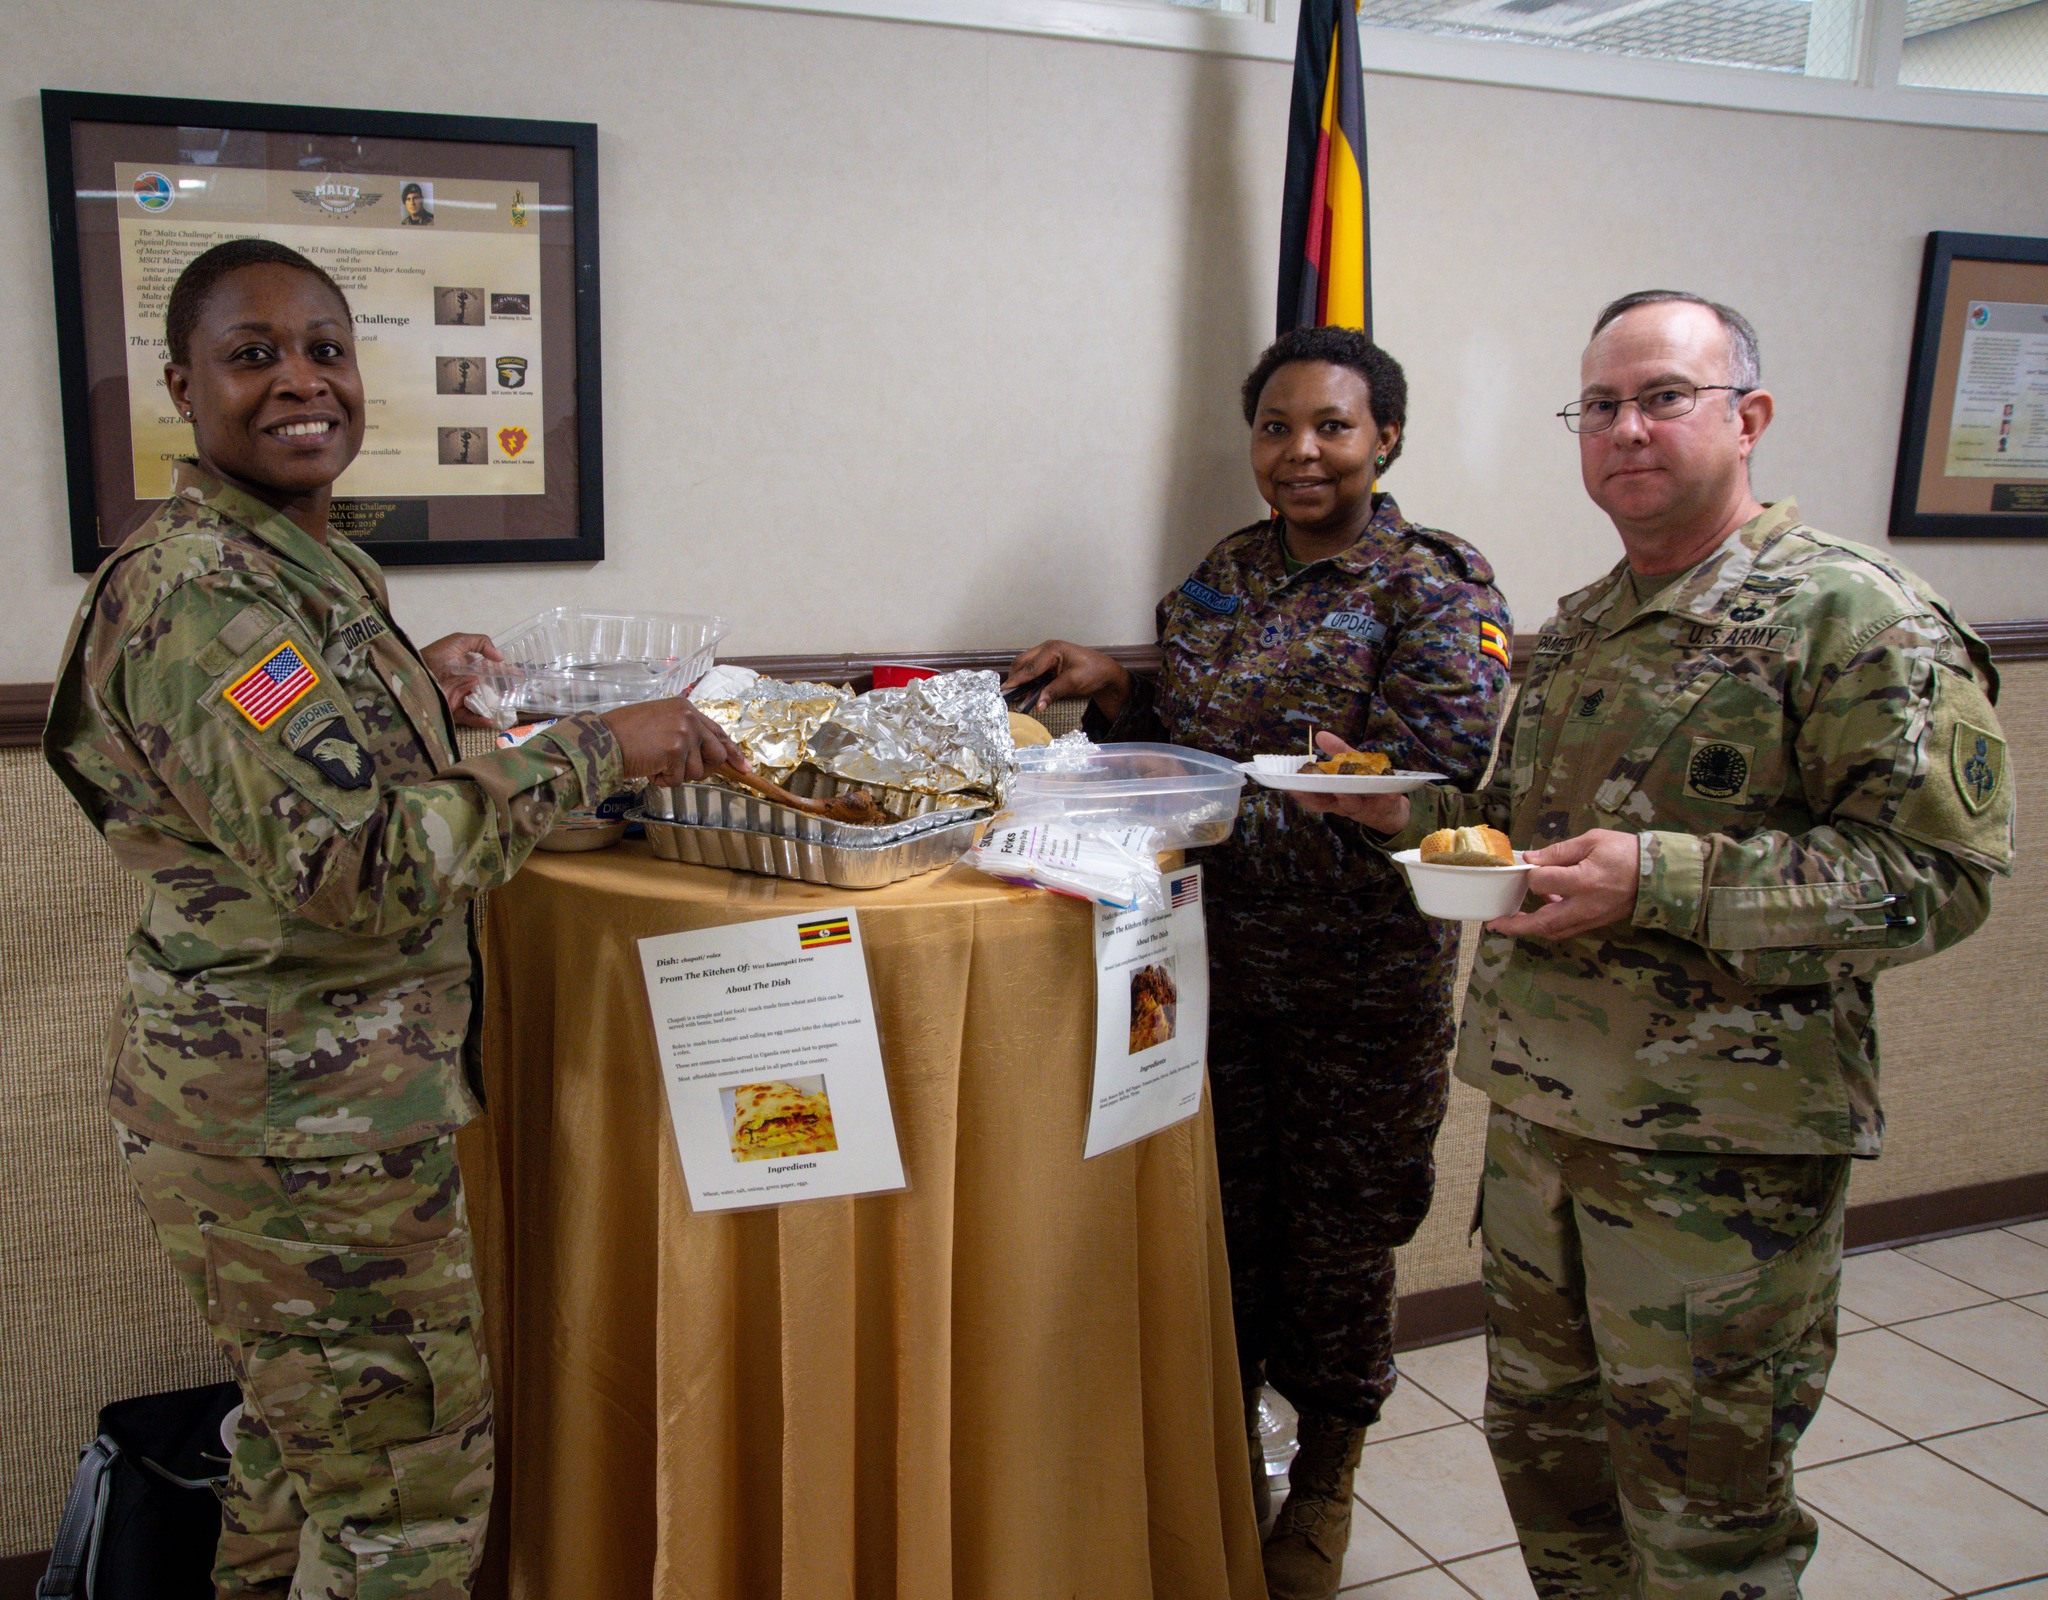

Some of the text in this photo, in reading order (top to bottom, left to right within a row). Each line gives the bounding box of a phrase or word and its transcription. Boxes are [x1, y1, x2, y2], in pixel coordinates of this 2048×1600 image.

[315, 184, 360, 197] MALTZ
[338, 247, 375, 255] Intelligence
[339, 265, 372, 273] Sergeants
[396, 267, 425, 275] Academy
[355, 314, 410, 326] Challenge
[130, 336, 149, 346] The
[360, 503, 396, 511] Challenge
[1331, 613, 1375, 635] UPDAF
[341, 615, 386, 650] ODRIGU
[1723, 627, 1780, 647] ARMY
[288, 701, 337, 743] AIRBORNE
[1001, 833, 1016, 853] Forks
[1017, 840, 1027, 855] Heavy
[1102, 929, 1115, 938] From
[1116, 926, 1124, 934] The
[1124, 920, 1141, 931] Kitchen
[1136, 930, 1168, 946] About The Dish
[657, 958, 679, 967] Dish:
[660, 976, 683, 984] From
[685, 972, 701, 980] The
[703, 968, 736, 978] Kitchen
[737, 964, 750, 973] Of:
[726, 978, 791, 994] About The Dish
[667, 1016, 687, 1024] Chapati
[760, 1050, 779, 1058] Uganda
[1139, 1058, 1166, 1073] Ingredients
[692, 1072, 717, 1081] affordable
[768, 1162, 817, 1174] Ingredients
